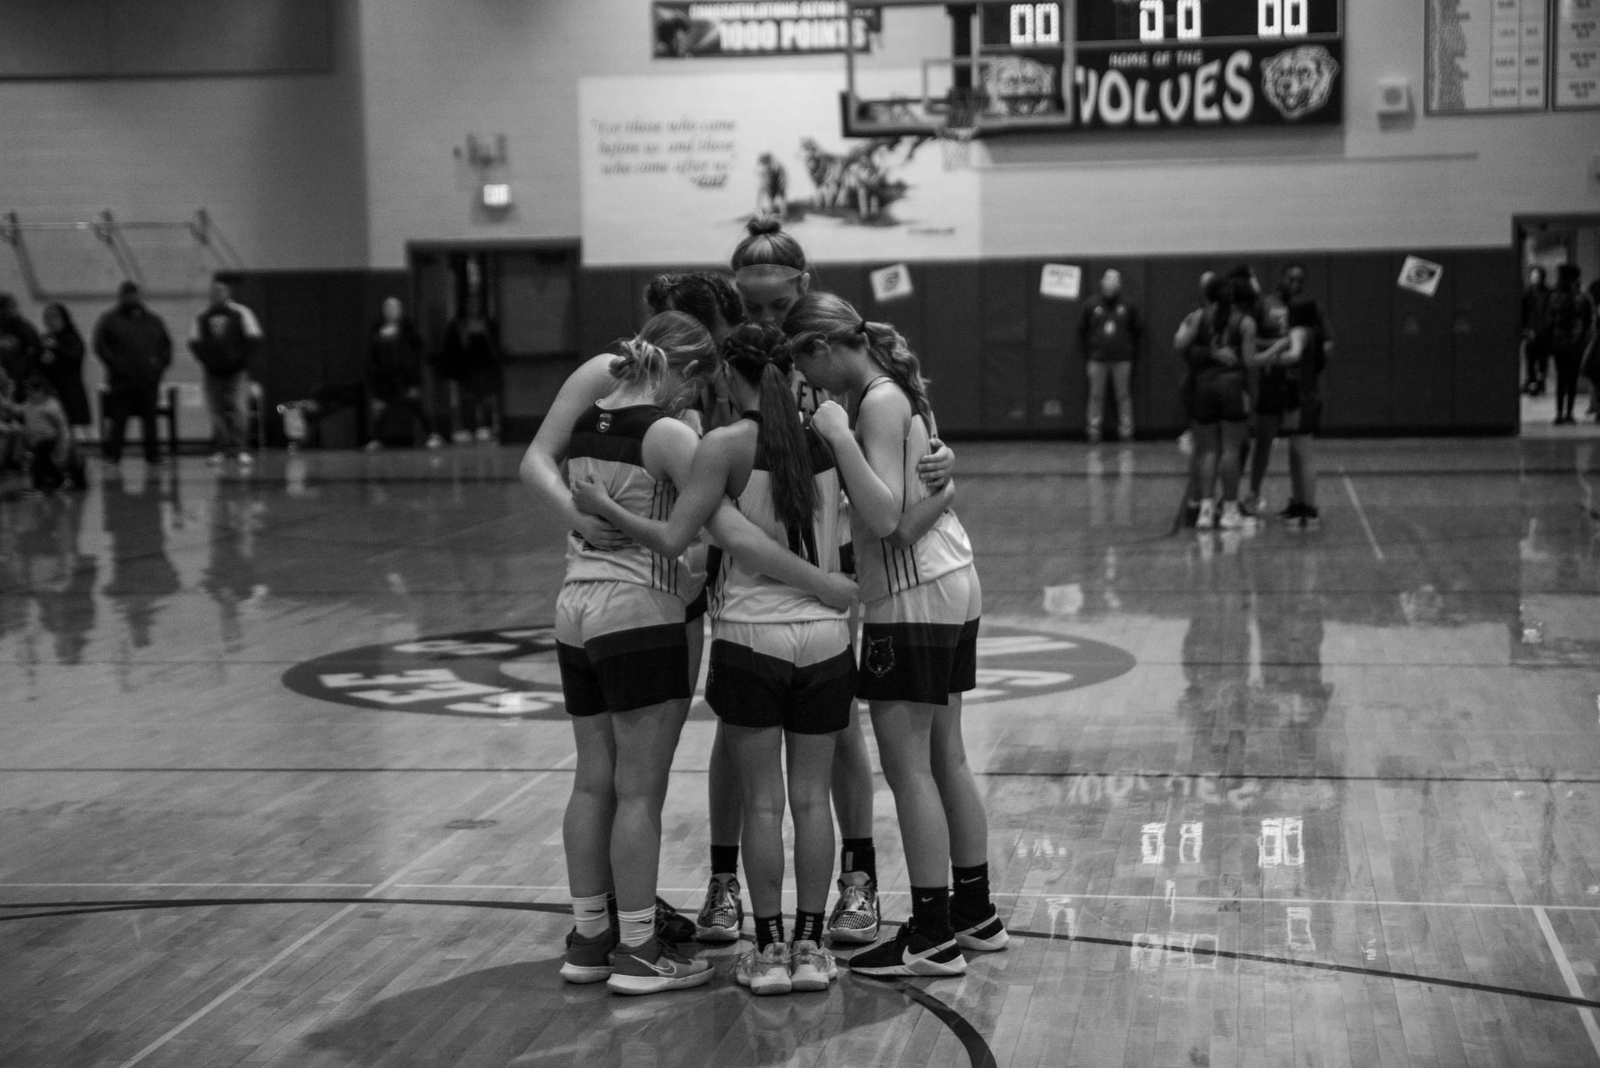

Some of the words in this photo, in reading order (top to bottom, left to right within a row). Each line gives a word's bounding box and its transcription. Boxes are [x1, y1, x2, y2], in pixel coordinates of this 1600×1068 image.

[719, 19, 777, 51] 1000
[780, 17, 867, 50] POINTS
[1108, 51, 1148, 67] HOME
[1152, 51, 1171, 66] OF
[1175, 49, 1204, 65] THE
